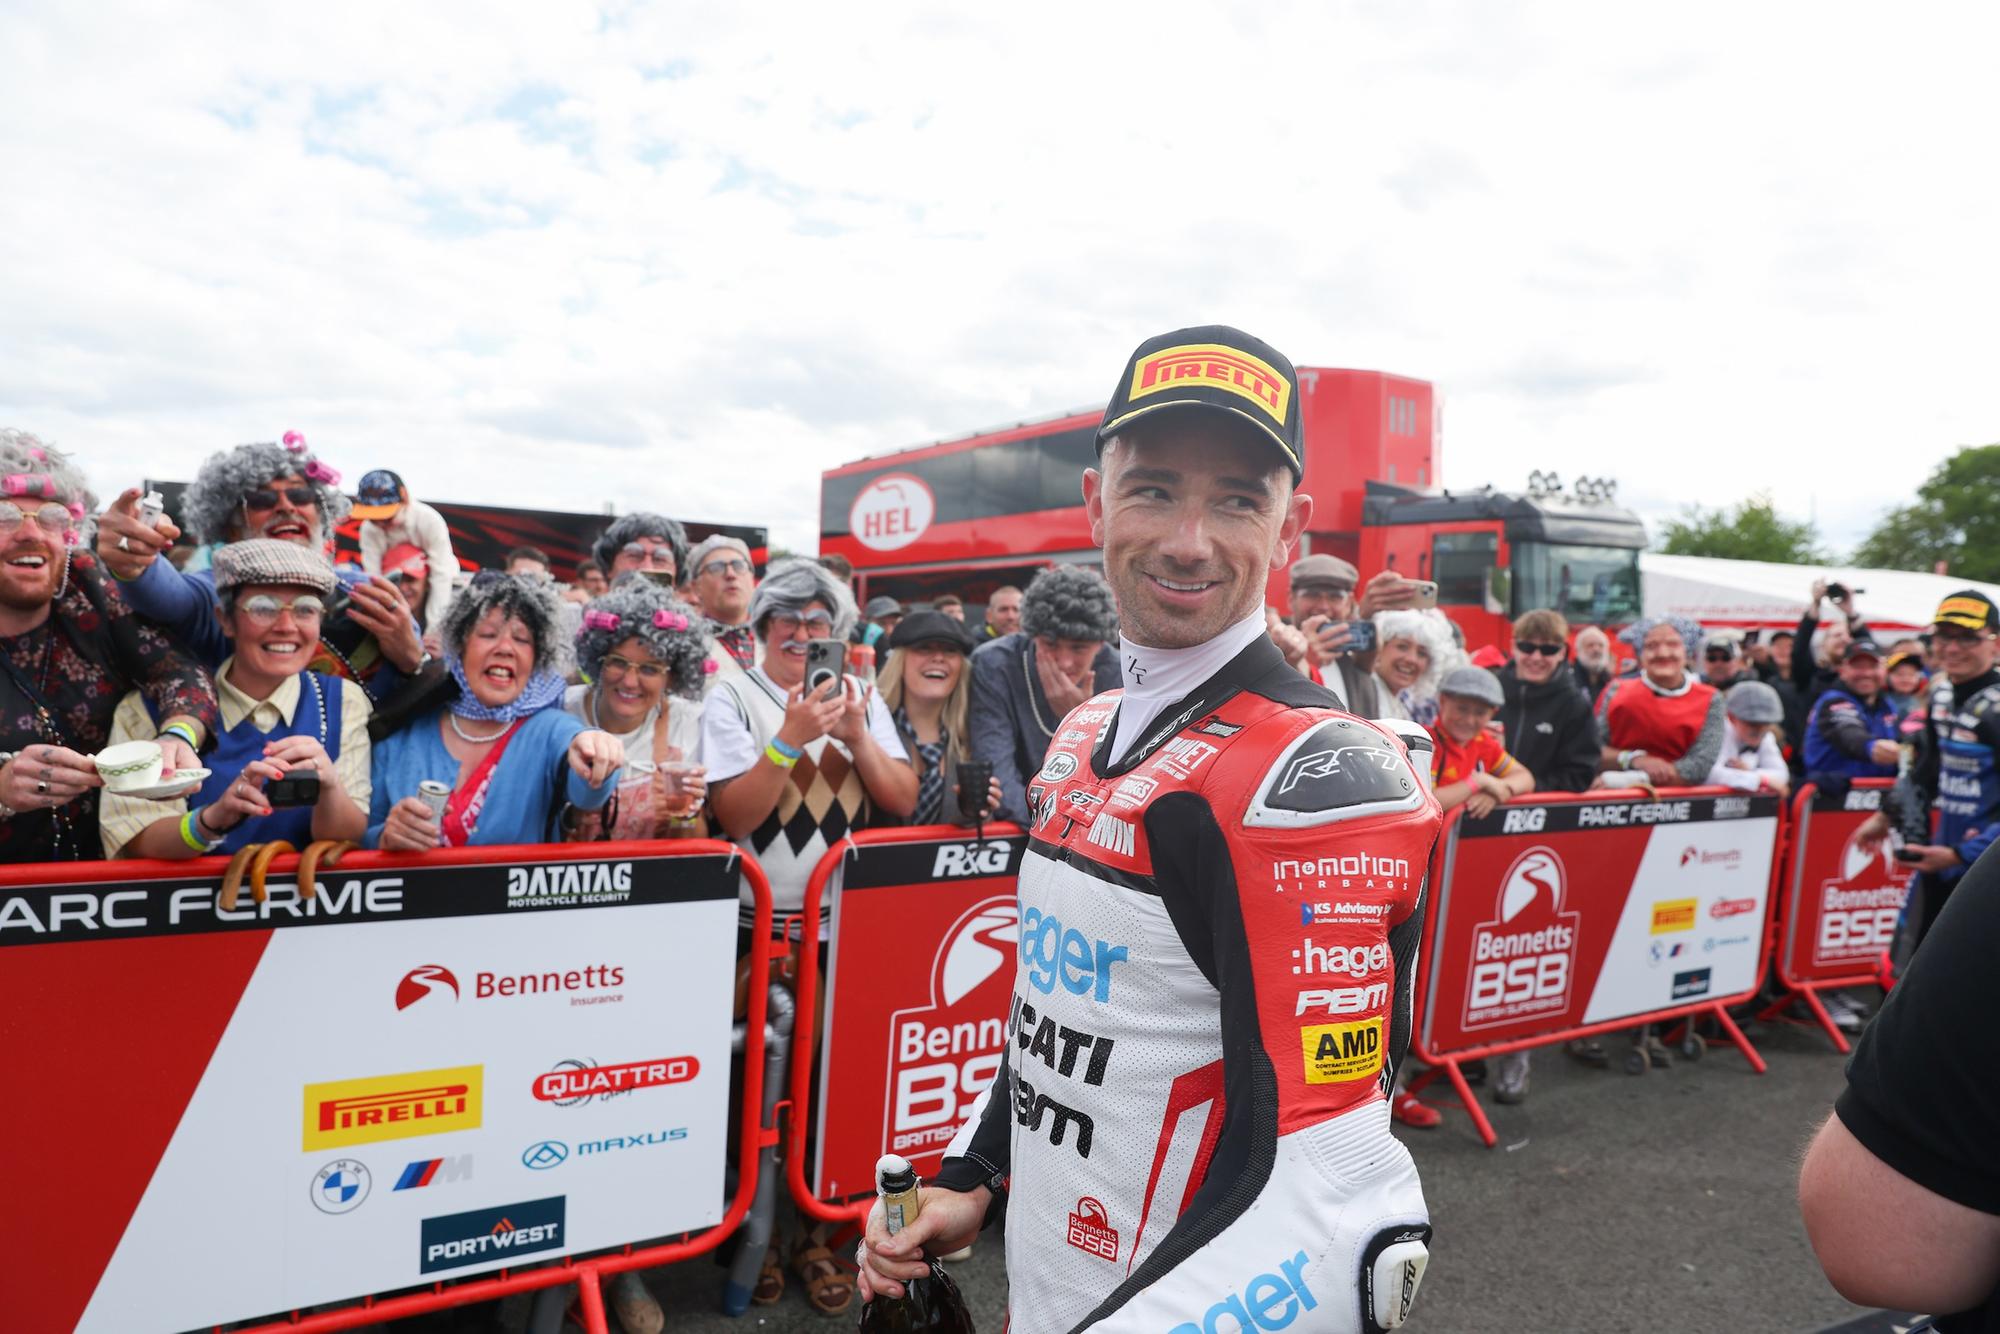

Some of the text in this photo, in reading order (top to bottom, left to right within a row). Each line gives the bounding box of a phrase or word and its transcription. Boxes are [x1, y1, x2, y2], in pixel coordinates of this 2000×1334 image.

[1140, 352, 1282, 409] PIRELLI
[864, 506, 918, 538] HEL
[1503, 808, 1547, 833] R&G
[1578, 805, 1629, 827] PARC
[1630, 802, 1692, 823] FERME
[932, 840, 1012, 877] R&G
[508, 862, 632, 898] DATATAG
[0, 878, 404, 933] ARC FERME
[507, 892, 631, 909] MOTORCYCLE SECURITY
[1314, 903, 1331, 914] KS
[1334, 902, 1384, 917] Advisory
[1476, 925, 1572, 961] Bennetts
[476, 964, 625, 998] Bennetts
[1470, 952, 1569, 1009] BSB
[570, 993, 624, 1007] Insurance
[899, 1018, 1009, 1063] Benn
[1008, 991, 1115, 1087] UCATI
[1315, 1027, 1378, 1060] AMD
[542, 1061, 688, 1097] QUATTRO
[1316, 1061, 1345, 1069] CONTRACT
[318, 1084, 469, 1132] PIRELLI
[895, 1053, 1004, 1132] BS
[577, 1127, 689, 1156] MAXUS
[320, 1161, 364, 1180] BMW
[428, 1222, 559, 1262] PORTWEST
[1070, 1227, 1116, 1258] BSB
[1071, 1216, 1116, 1242] Bennetts
